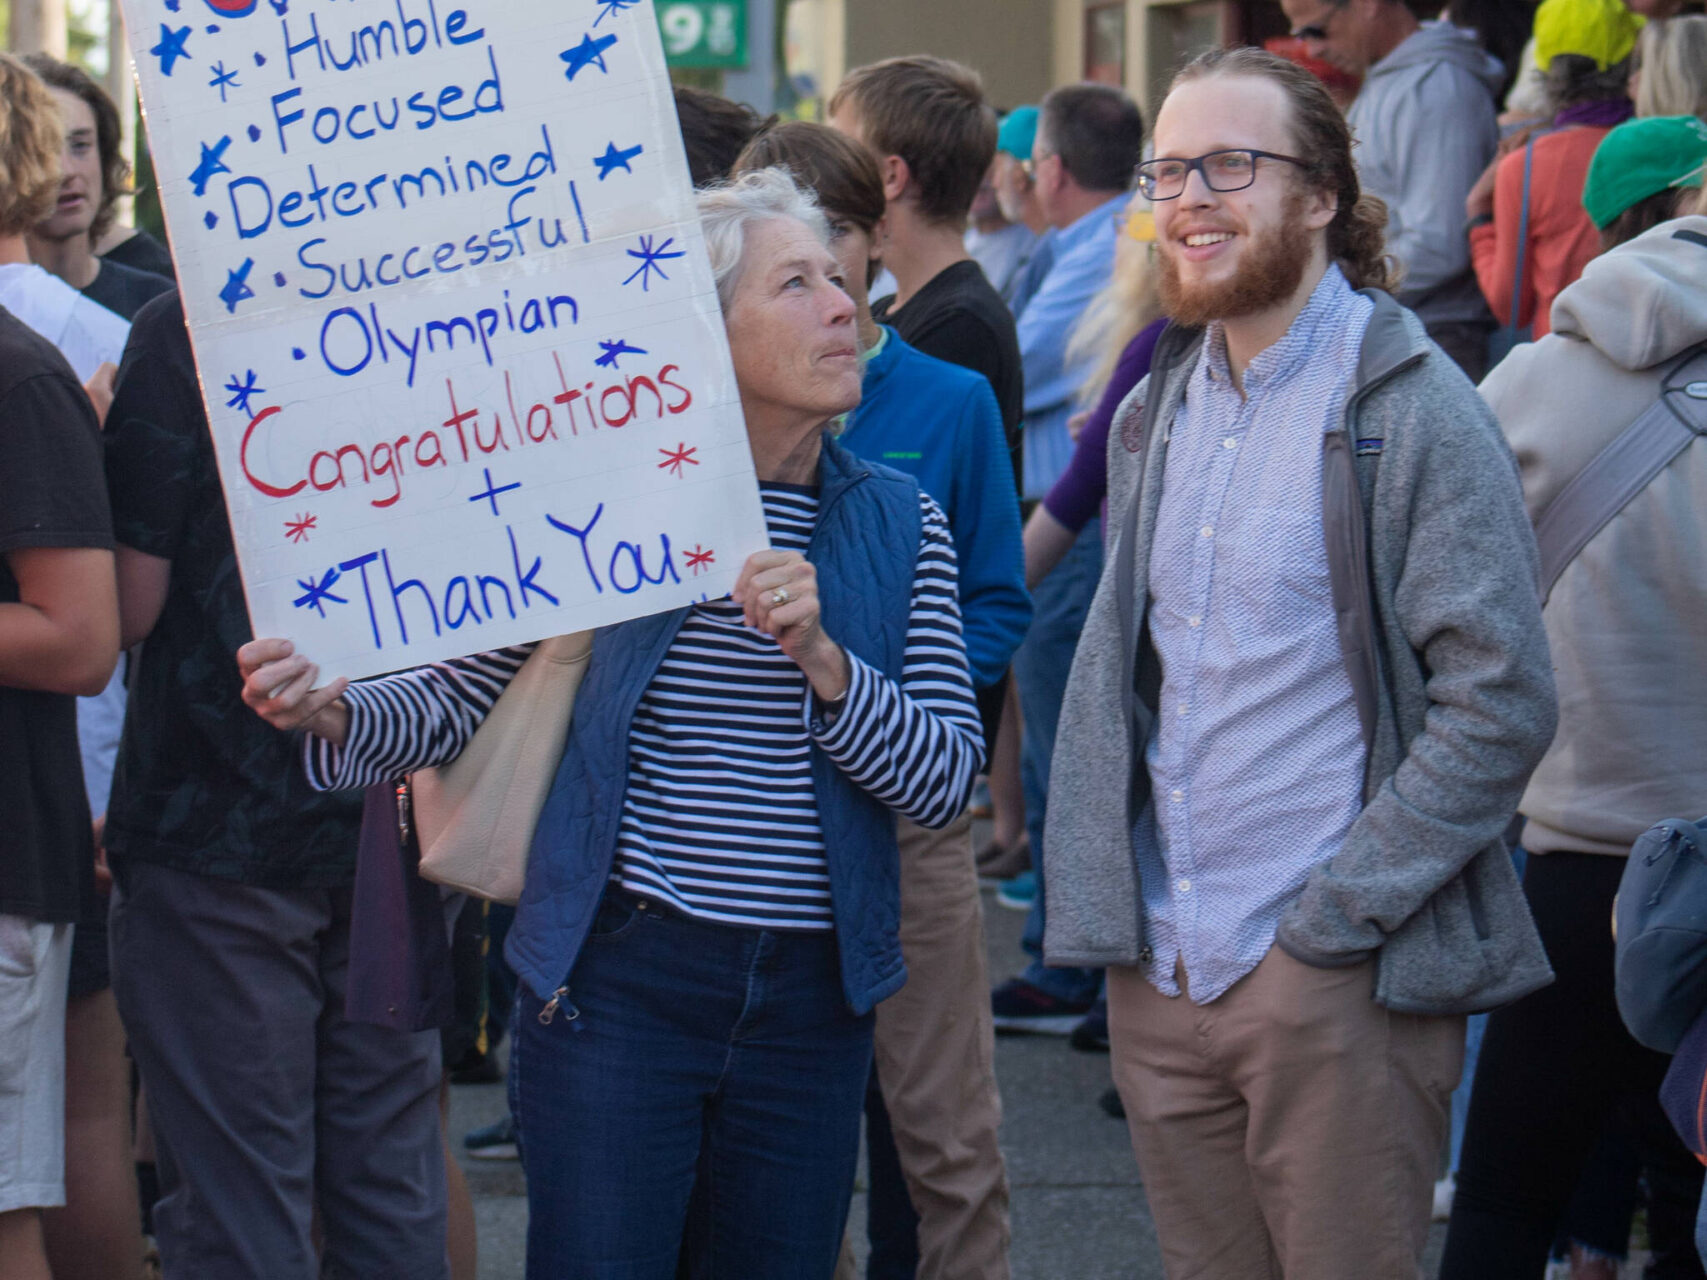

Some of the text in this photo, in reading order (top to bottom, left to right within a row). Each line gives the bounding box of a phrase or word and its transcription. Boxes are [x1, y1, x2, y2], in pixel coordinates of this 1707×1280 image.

[271, 45, 505, 154] Focused
[228, 124, 557, 239] Determined
[298, 181, 590, 299] Successful
[320, 290, 579, 387] Olympian
[240, 351, 692, 508] Congratulations
[469, 468, 521, 516] +
[338, 503, 681, 649] Thank You
